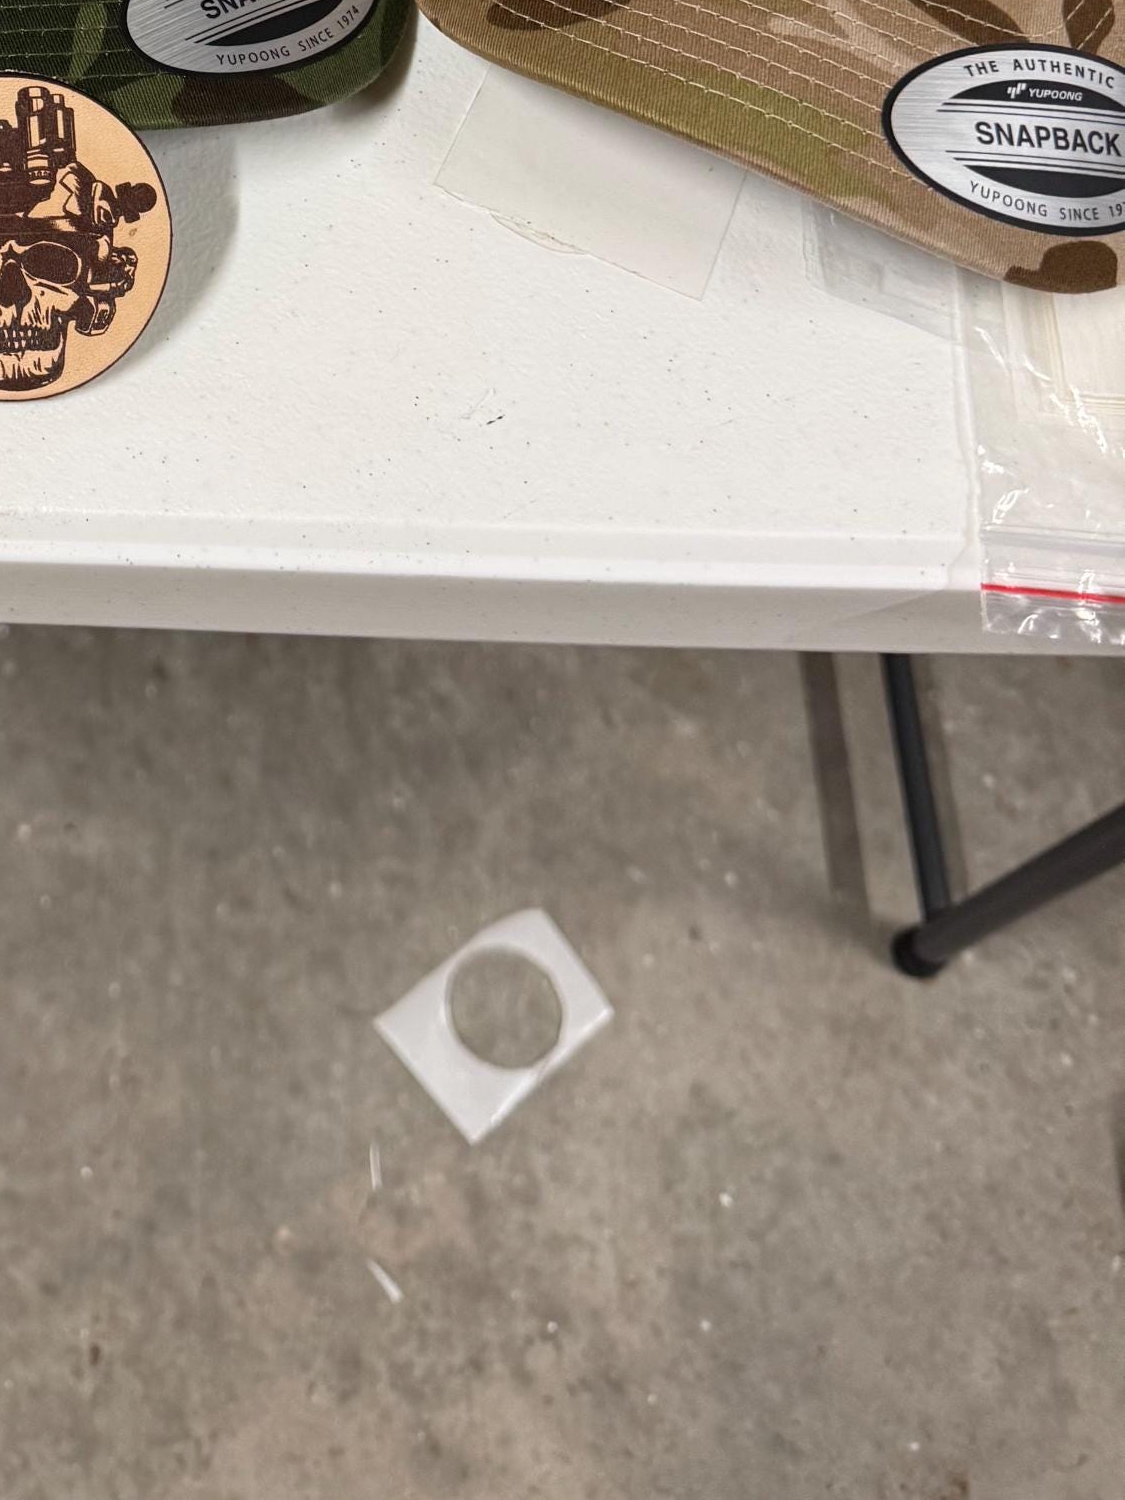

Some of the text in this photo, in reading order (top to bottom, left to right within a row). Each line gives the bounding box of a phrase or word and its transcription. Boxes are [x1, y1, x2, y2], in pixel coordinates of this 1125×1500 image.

[216, 4, 361, 66] YUPOONG SINCE 1974
[964, 58, 1115, 89] THE AUTHENTIC
[1028, 88, 1083, 101] YUPOONG
[975, 121, 1121, 156] SNAPBACK
[970, 180, 1125, 221] YUPOONG SINCE 19
